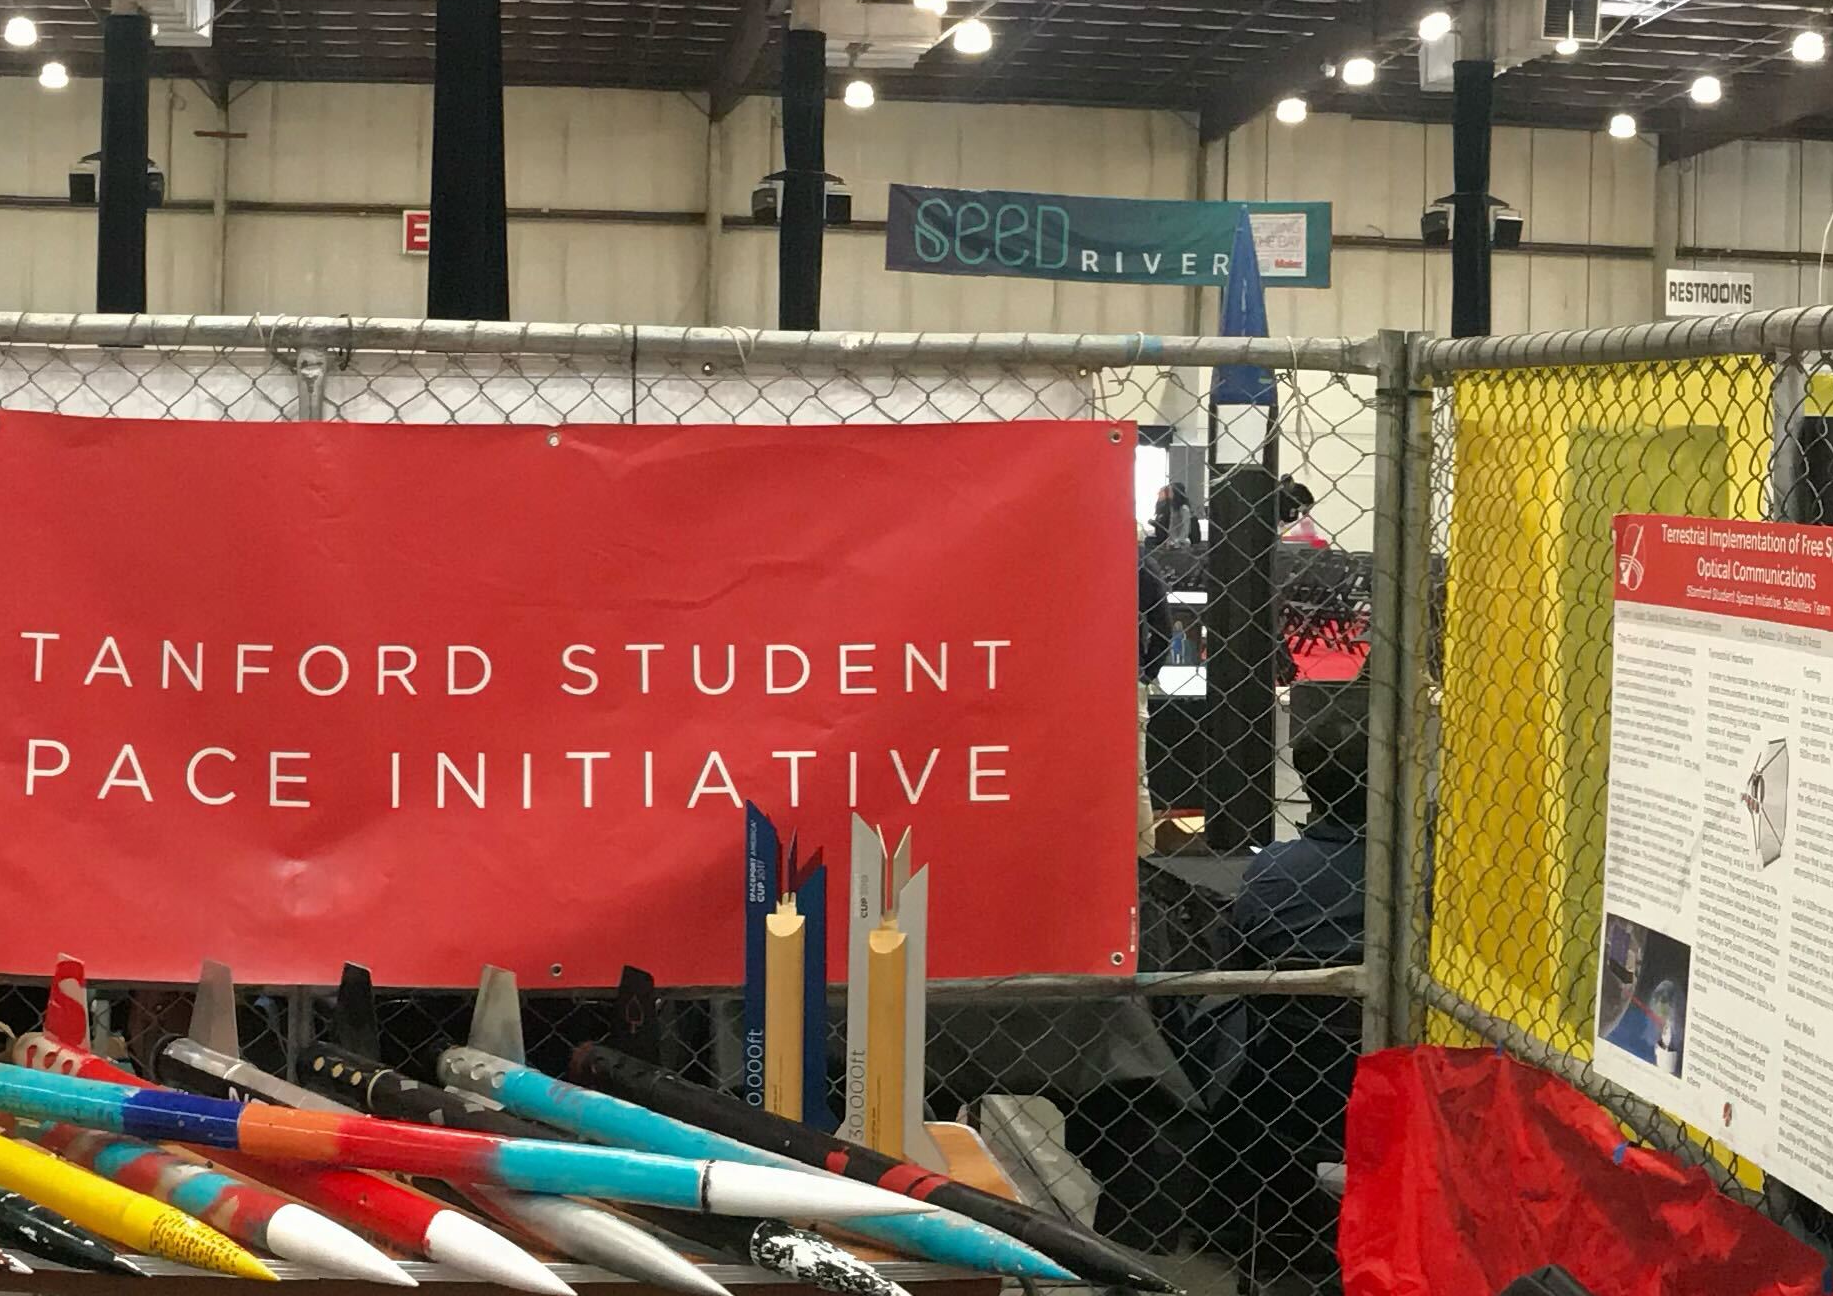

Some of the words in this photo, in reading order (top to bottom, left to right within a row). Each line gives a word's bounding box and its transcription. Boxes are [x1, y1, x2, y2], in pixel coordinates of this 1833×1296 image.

[1080, 249, 1229, 276] RIVER
[1661, 524, 1708, 546] Terrestrial
[1710, 525, 1786, 554] Implementation
[1788, 535, 1800, 553] of
[1802, 534, 1824, 557] Free
[1697, 557, 1731, 581] Optical
[1733, 563, 1817, 590] Communications
[560, 637, 1013, 696] STUDENT
[391, 743, 1011, 810] INITIATIVE
[747, 1029, 764, 1106] 0,000ft
[849, 1049, 865, 1141] 30,000ft
